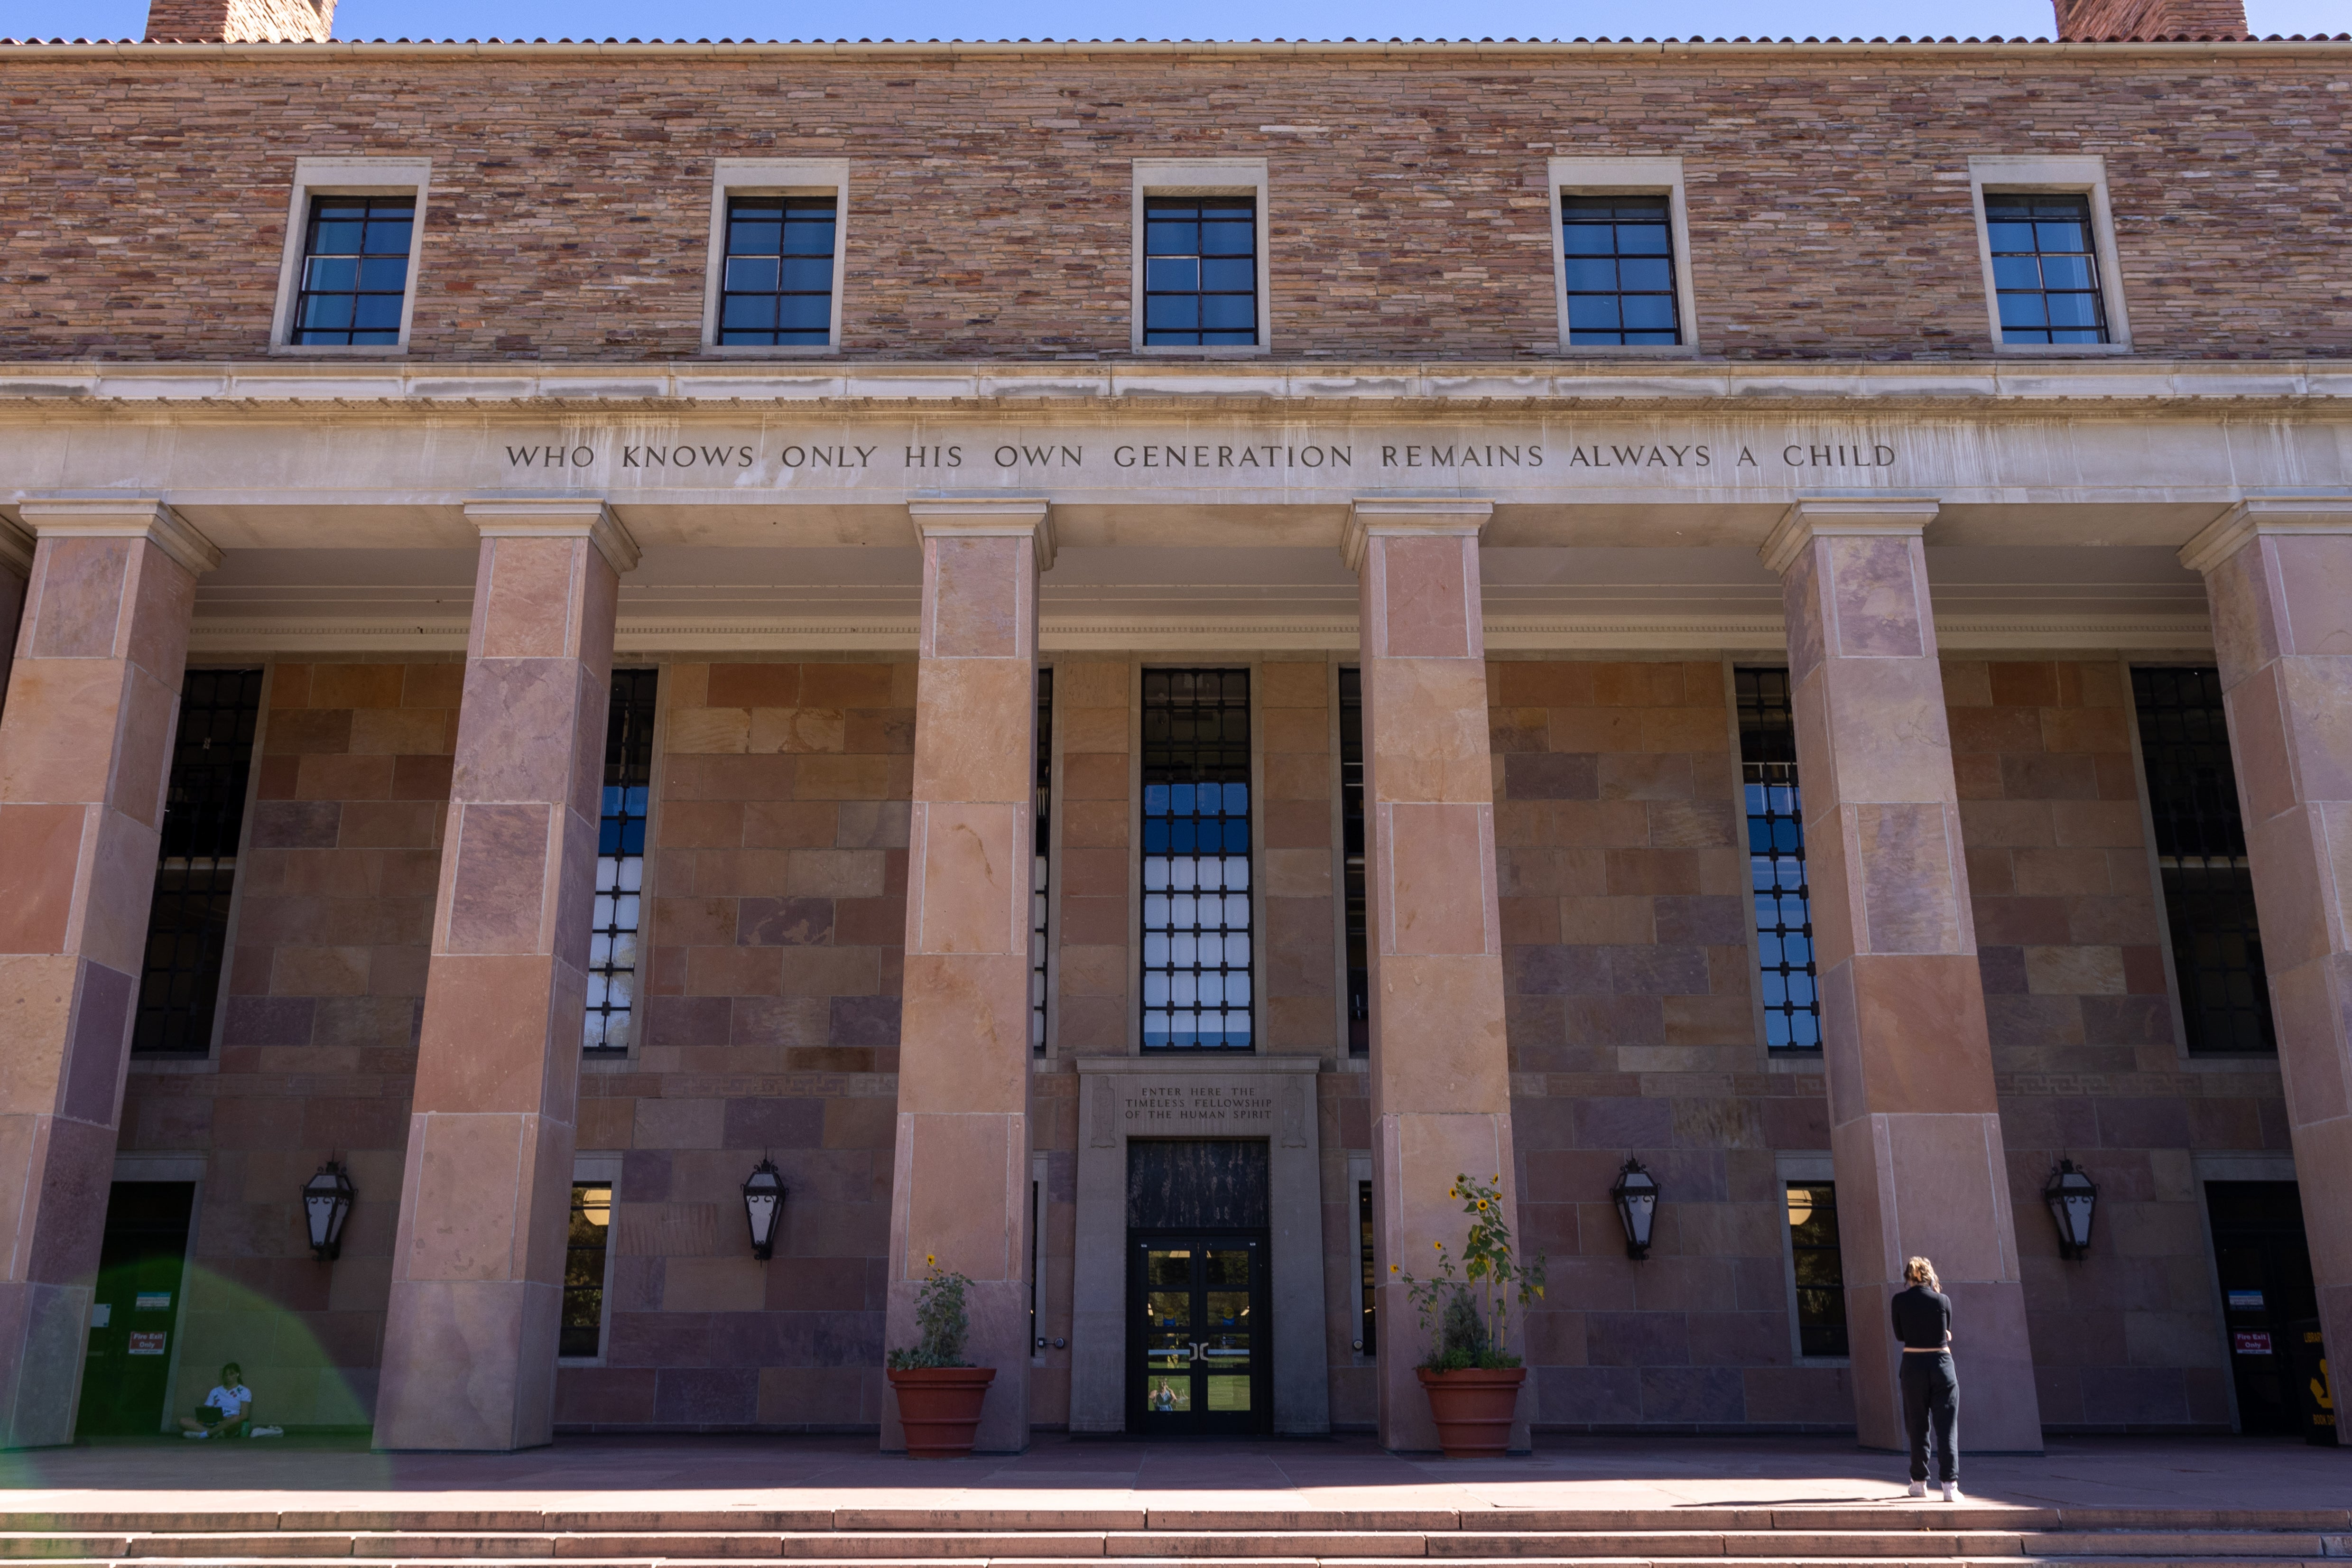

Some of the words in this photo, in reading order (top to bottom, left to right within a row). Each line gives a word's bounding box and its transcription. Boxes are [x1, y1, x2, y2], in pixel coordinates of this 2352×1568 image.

[505, 445, 594, 468] WHO
[621, 445, 753, 468] KNOWS
[781, 445, 879, 468] ONLY
[904, 445, 963, 468] HIS
[994, 445, 1083, 467] OWN
[1113, 445, 1352, 468] GENERATION
[1381, 445, 1544, 467] REMAINS
[1569, 445, 1711, 467] ALWAYS
[1736, 445, 1759, 467] A
[1783, 445, 1897, 467] CHILD
[1142, 1087, 1181, 1096] ENTER
[1191, 1087, 1221, 1096] HERE
[1232, 1087, 1255, 1095] THE
[1125, 1099, 1185, 1107] TIMELESS
[1195, 1099, 1272, 1107] FELLOWSHIP
[1125, 1111, 1139, 1119] OF
[1148, 1111, 1172, 1119] THE
[1180, 1111, 1225, 1119] HUMAN
[1234, 1111, 1272, 1119] SPIRIT
